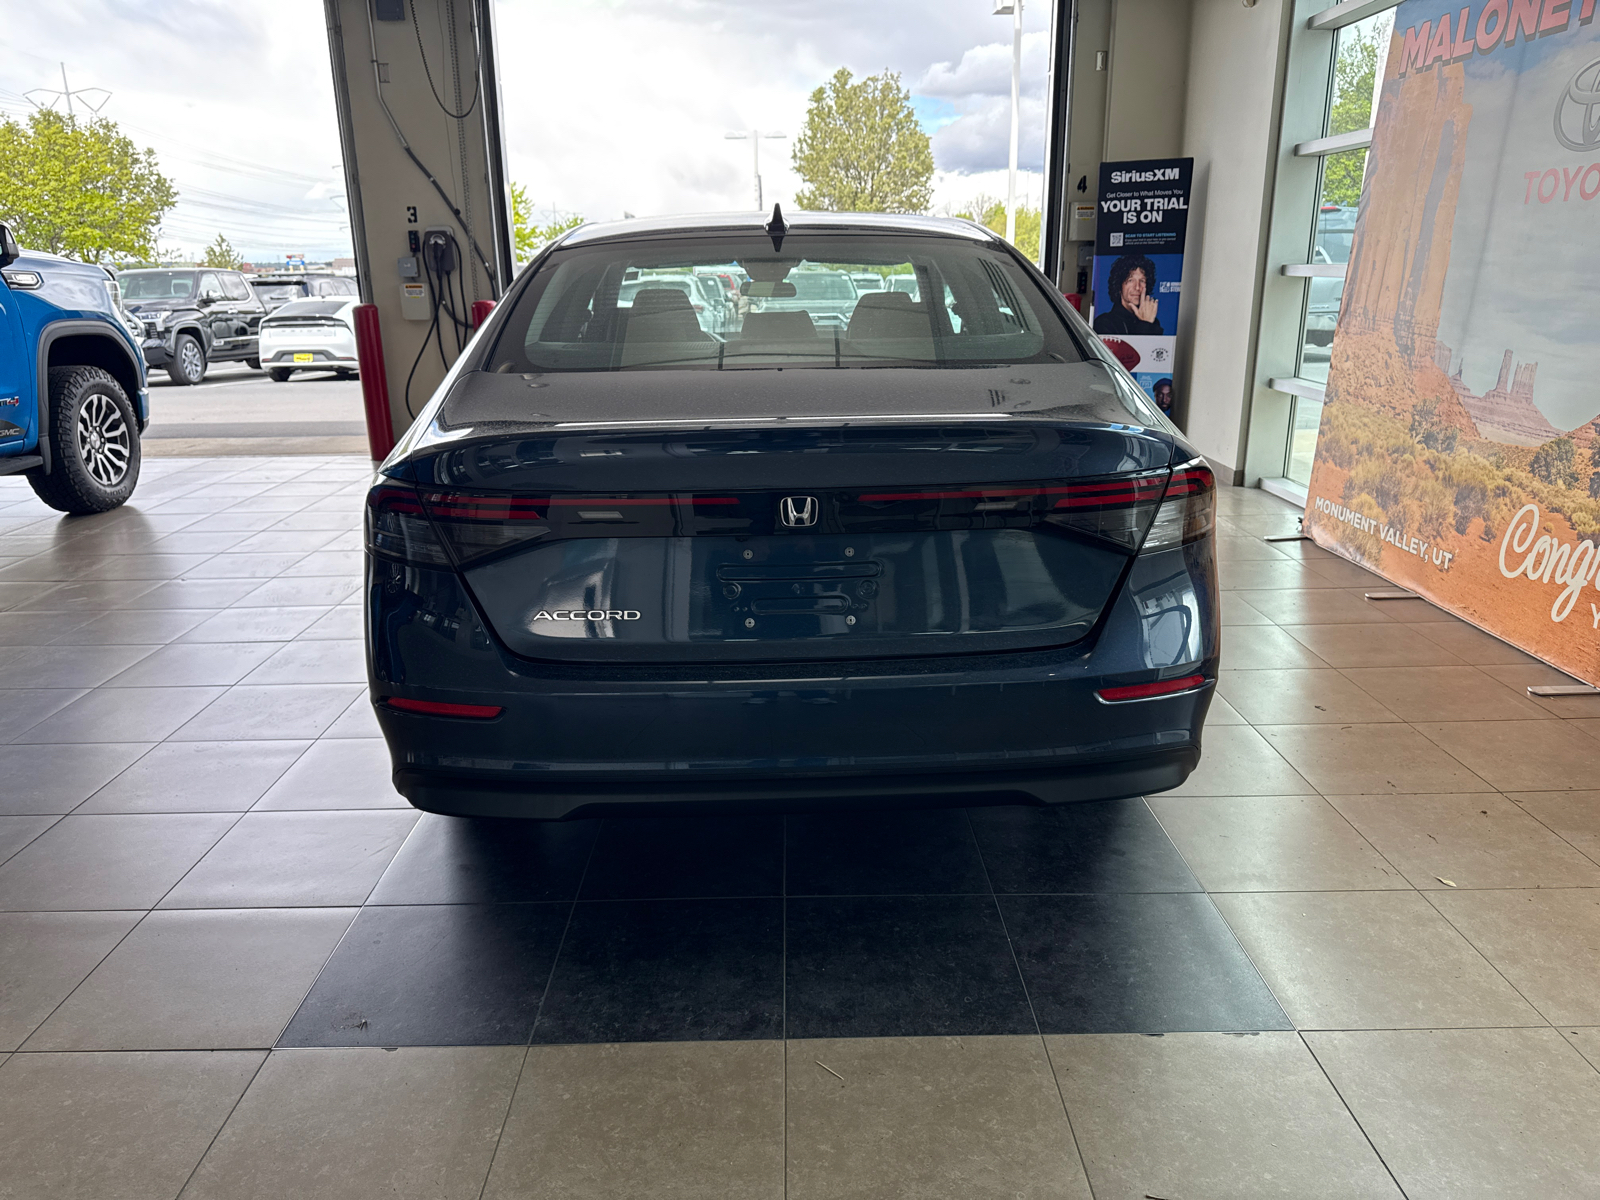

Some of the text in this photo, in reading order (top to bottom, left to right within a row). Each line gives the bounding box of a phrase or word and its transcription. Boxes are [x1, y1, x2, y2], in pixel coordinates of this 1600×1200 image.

[1111, 168, 1180, 184] SiriusXM
[1077, 175, 1087, 194] 4
[1101, 197, 1188, 213] YOUR TRIAL
[406, 206, 418, 223] 3
[1123, 211, 1163, 224] IS ON
[1314, 496, 1453, 571] MONUMENT VALLEY, UT
[533, 610, 641, 621] ACCORD
